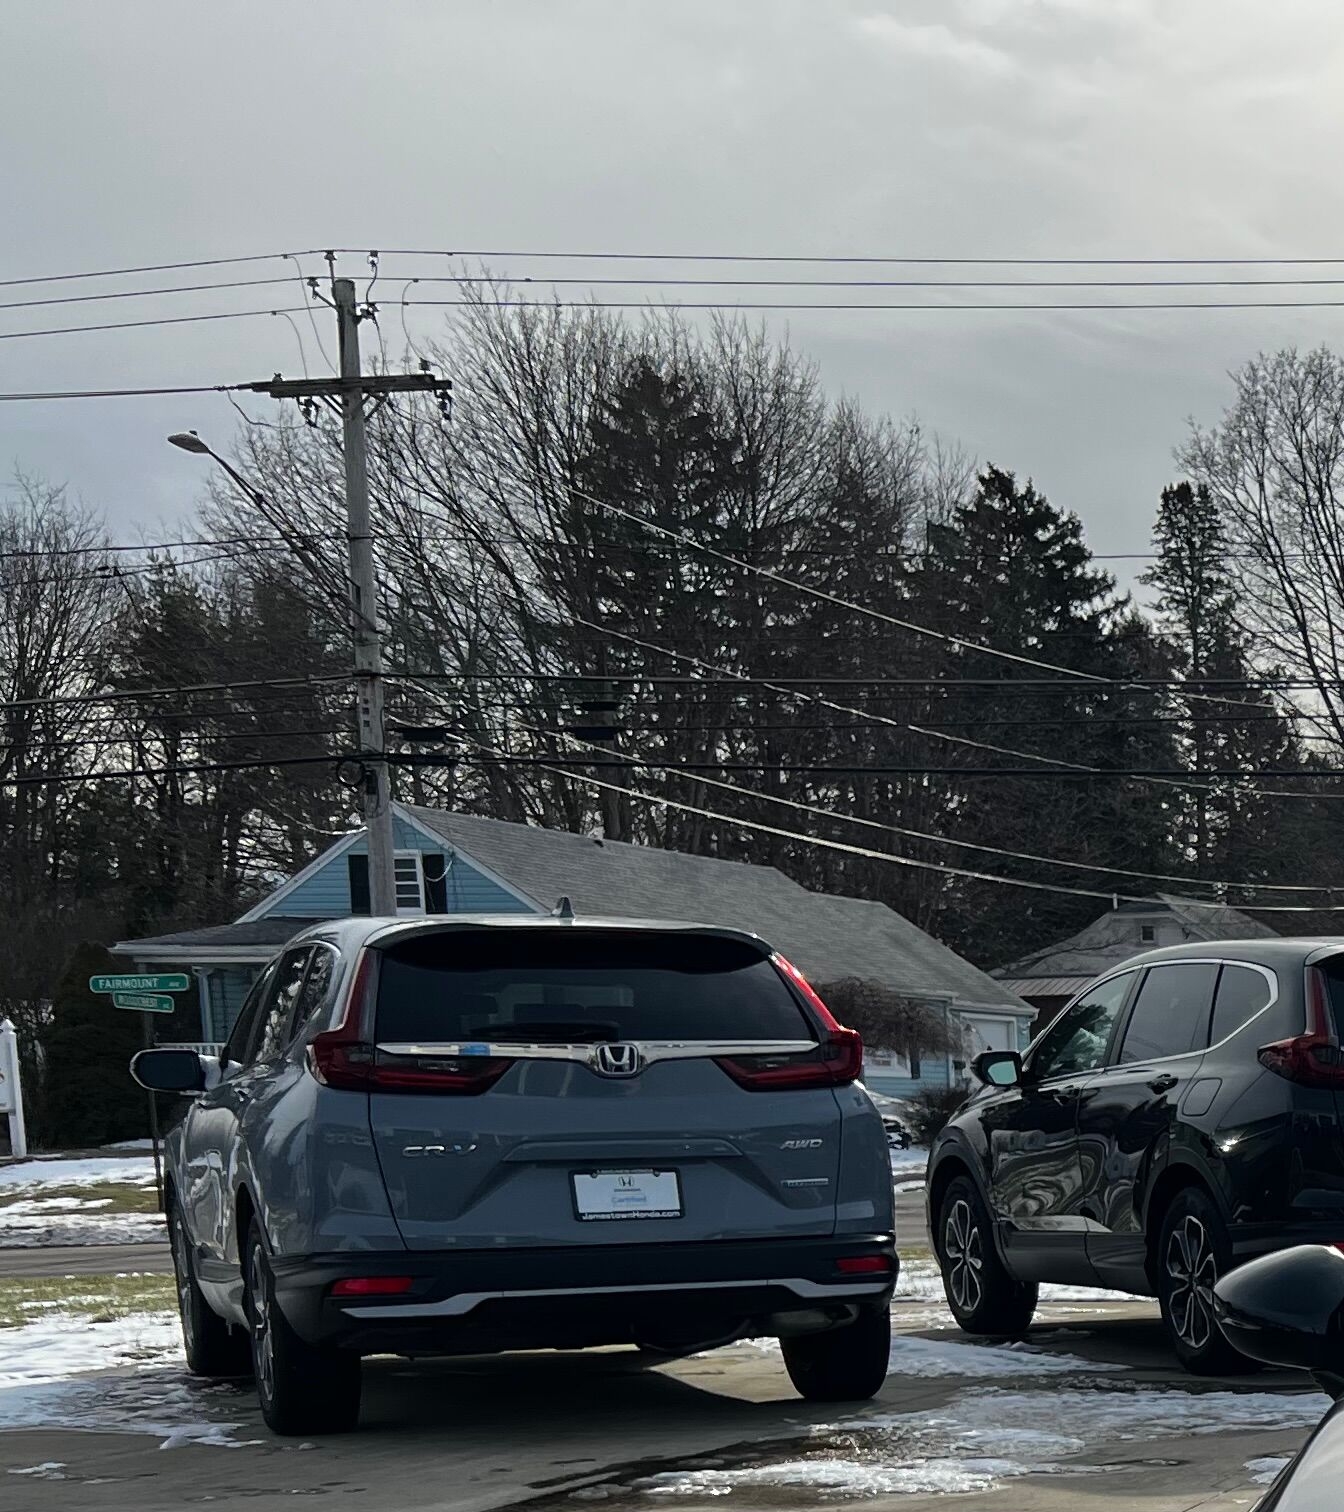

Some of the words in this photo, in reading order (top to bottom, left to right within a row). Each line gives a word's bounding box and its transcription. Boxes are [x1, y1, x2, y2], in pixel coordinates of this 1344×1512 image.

[98, 977, 160, 989] FAIRMOUNT
[780, 1138, 823, 1150] AWD
[402, 1144, 477, 1158] CR-V
